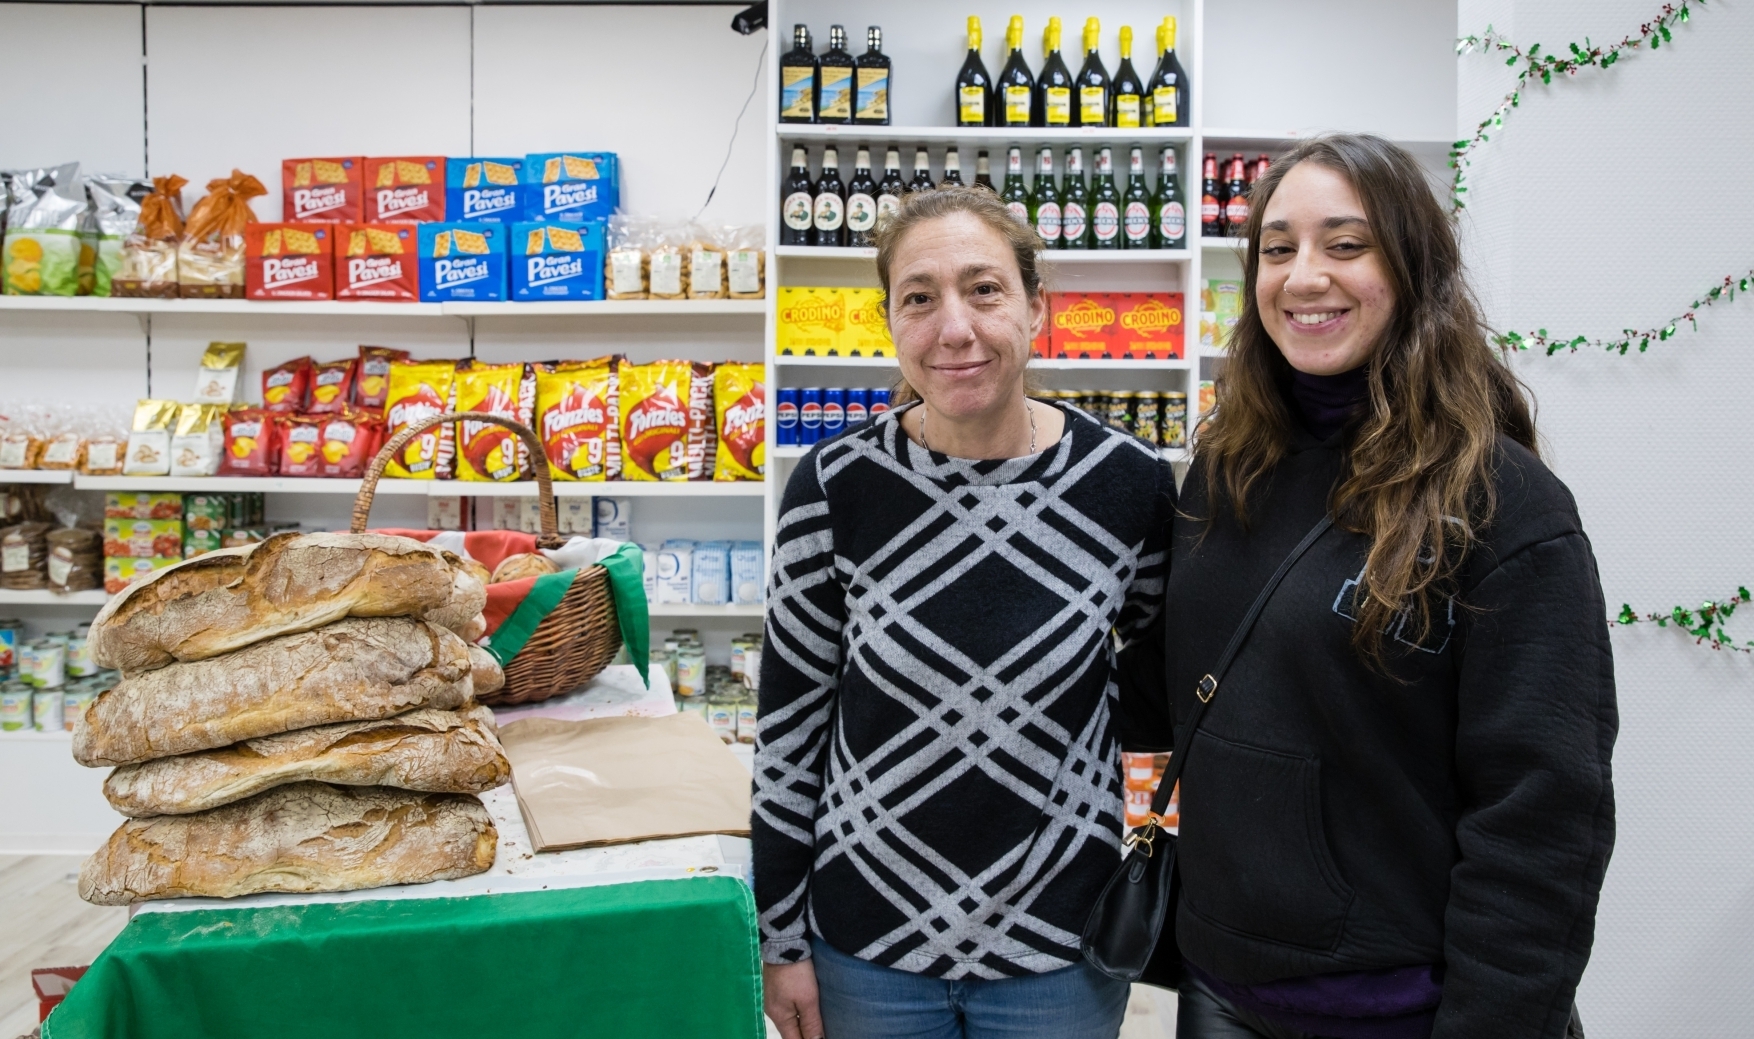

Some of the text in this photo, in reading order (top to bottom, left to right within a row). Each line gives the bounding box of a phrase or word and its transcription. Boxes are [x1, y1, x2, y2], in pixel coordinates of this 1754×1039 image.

[311, 187, 336, 197] Gran
[393, 188, 419, 197] Gran
[481, 188, 506, 198] Gran
[544, 184, 598, 209] Pavesi
[561, 183, 587, 193] Gran
[294, 189, 347, 213] Pavesi
[377, 190, 429, 214] Pavesi
[464, 190, 515, 213] Pavesi
[263, 259, 319, 284] Pavesi
[281, 258, 307, 267] Gran
[349, 259, 403, 284] Pavesi
[365, 258, 391, 267] Gran
[435, 260, 489, 285] Pavesi
[452, 258, 478, 268] Gran
[528, 258, 583, 283] Pavesi
[545, 256, 571, 266] Gran
[782, 305, 841, 322] CRODINO
[1056, 309, 1115, 327] CRODINO
[1122, 310, 1181, 327] CRODINO
[544, 407, 604, 441] Fonzies
[630, 406, 686, 440] Fonzies
[687, 376, 708, 478] MULTI-PACK
[420, 433, 436, 460] 9
[501, 437, 514, 465] 9
[588, 437, 602, 465] 9
[670, 440, 684, 468] 9
